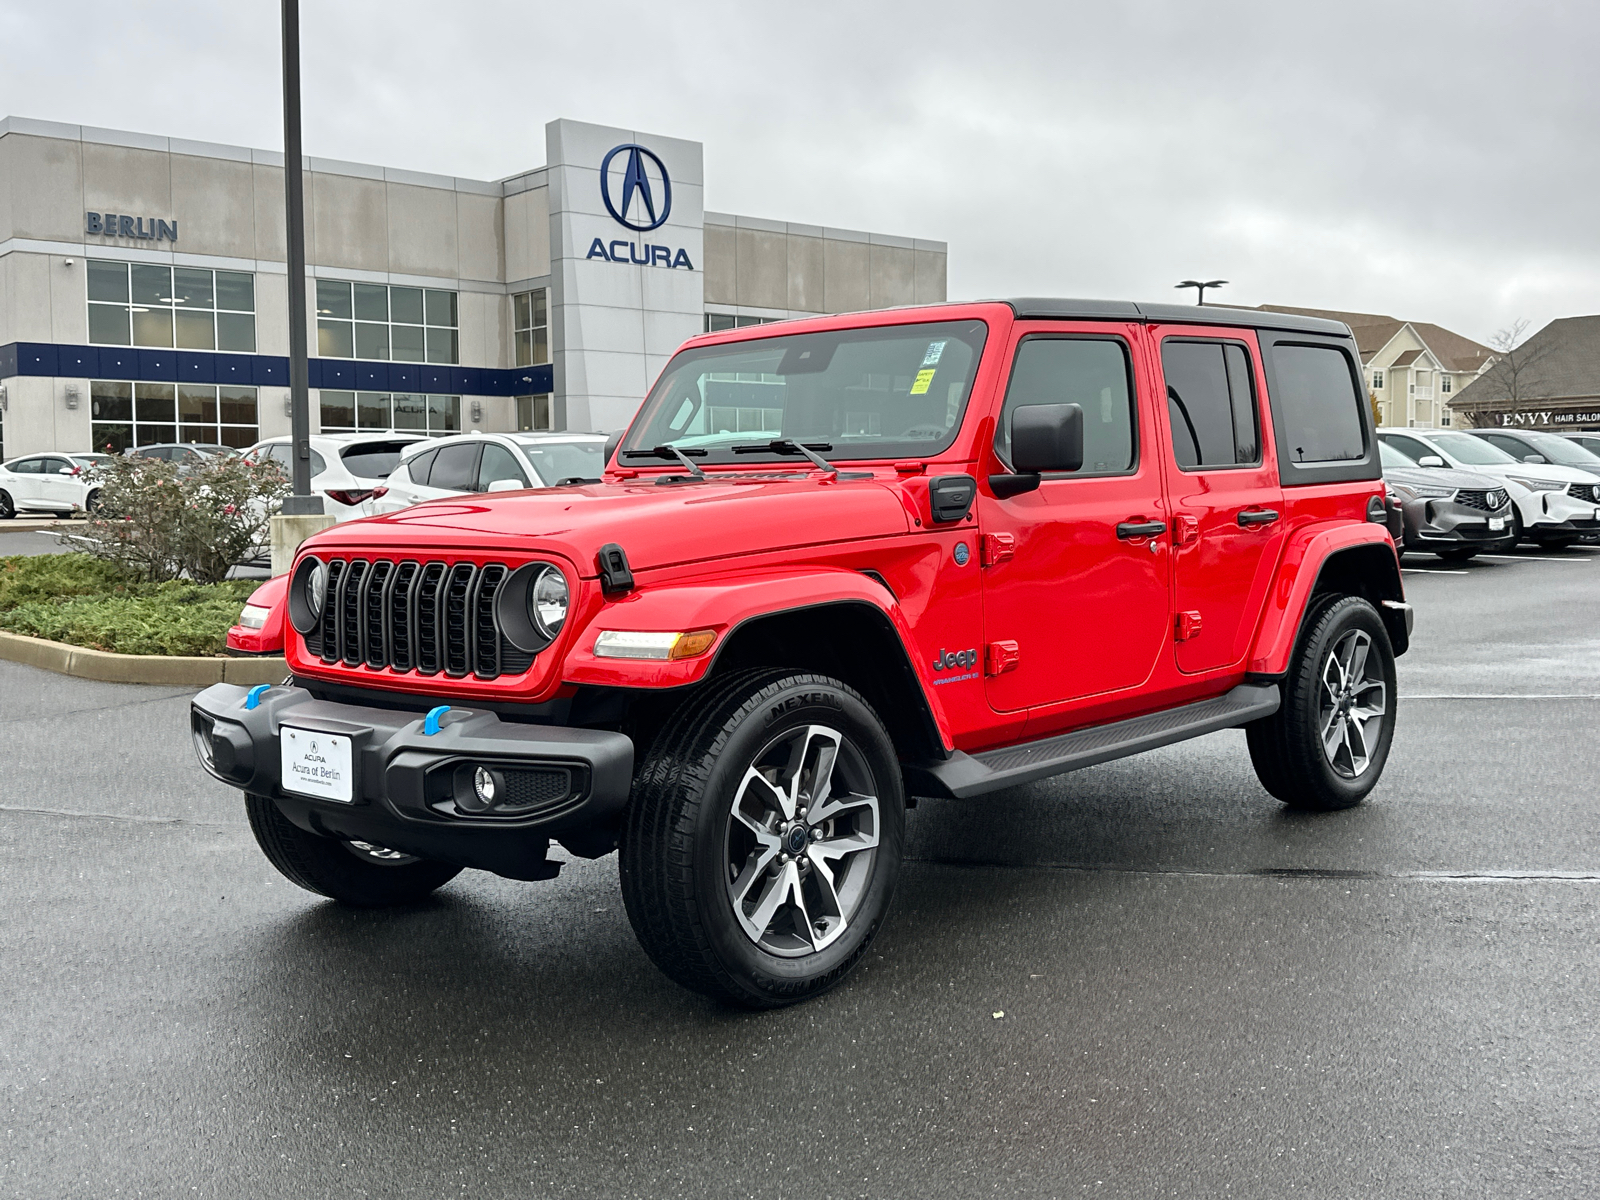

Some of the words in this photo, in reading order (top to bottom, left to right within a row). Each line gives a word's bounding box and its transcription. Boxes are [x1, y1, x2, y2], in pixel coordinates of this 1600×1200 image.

[87, 212, 177, 241] BERLIN
[586, 237, 694, 270] ACURA
[1502, 411, 1552, 426] ENVY
[1555, 414, 1574, 422] HAIR
[933, 648, 977, 671] Jeep
[771, 693, 835, 718] NEXEN
[304, 754, 326, 763] ACURA
[292, 762, 310, 774] Acura
[311, 767, 318, 776] of
[320, 767, 341, 780] Berlin
